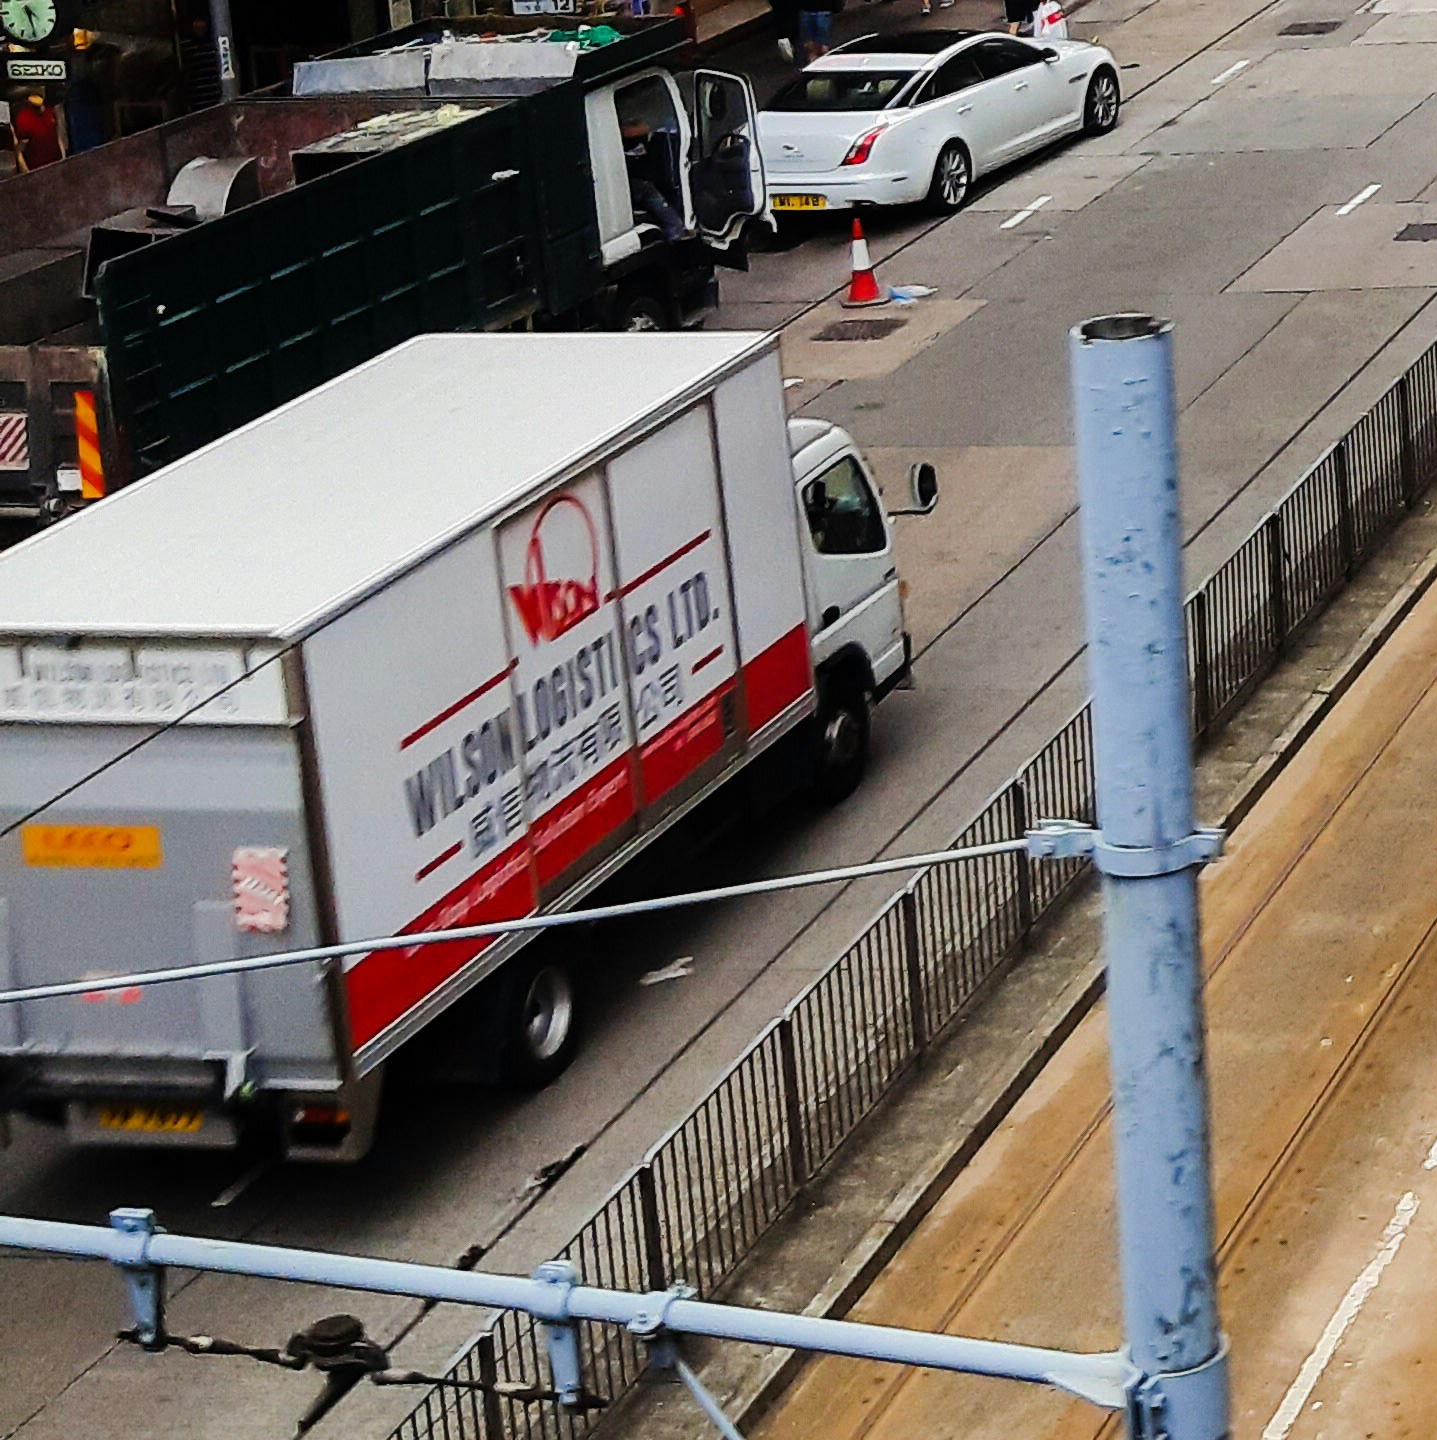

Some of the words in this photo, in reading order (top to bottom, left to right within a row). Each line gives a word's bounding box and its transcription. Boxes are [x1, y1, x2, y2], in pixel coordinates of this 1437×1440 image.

[405, 706, 518, 837] WILSON
[515, 603, 662, 752] LOGISTICS
[667, 571, 719, 651] LTD.
